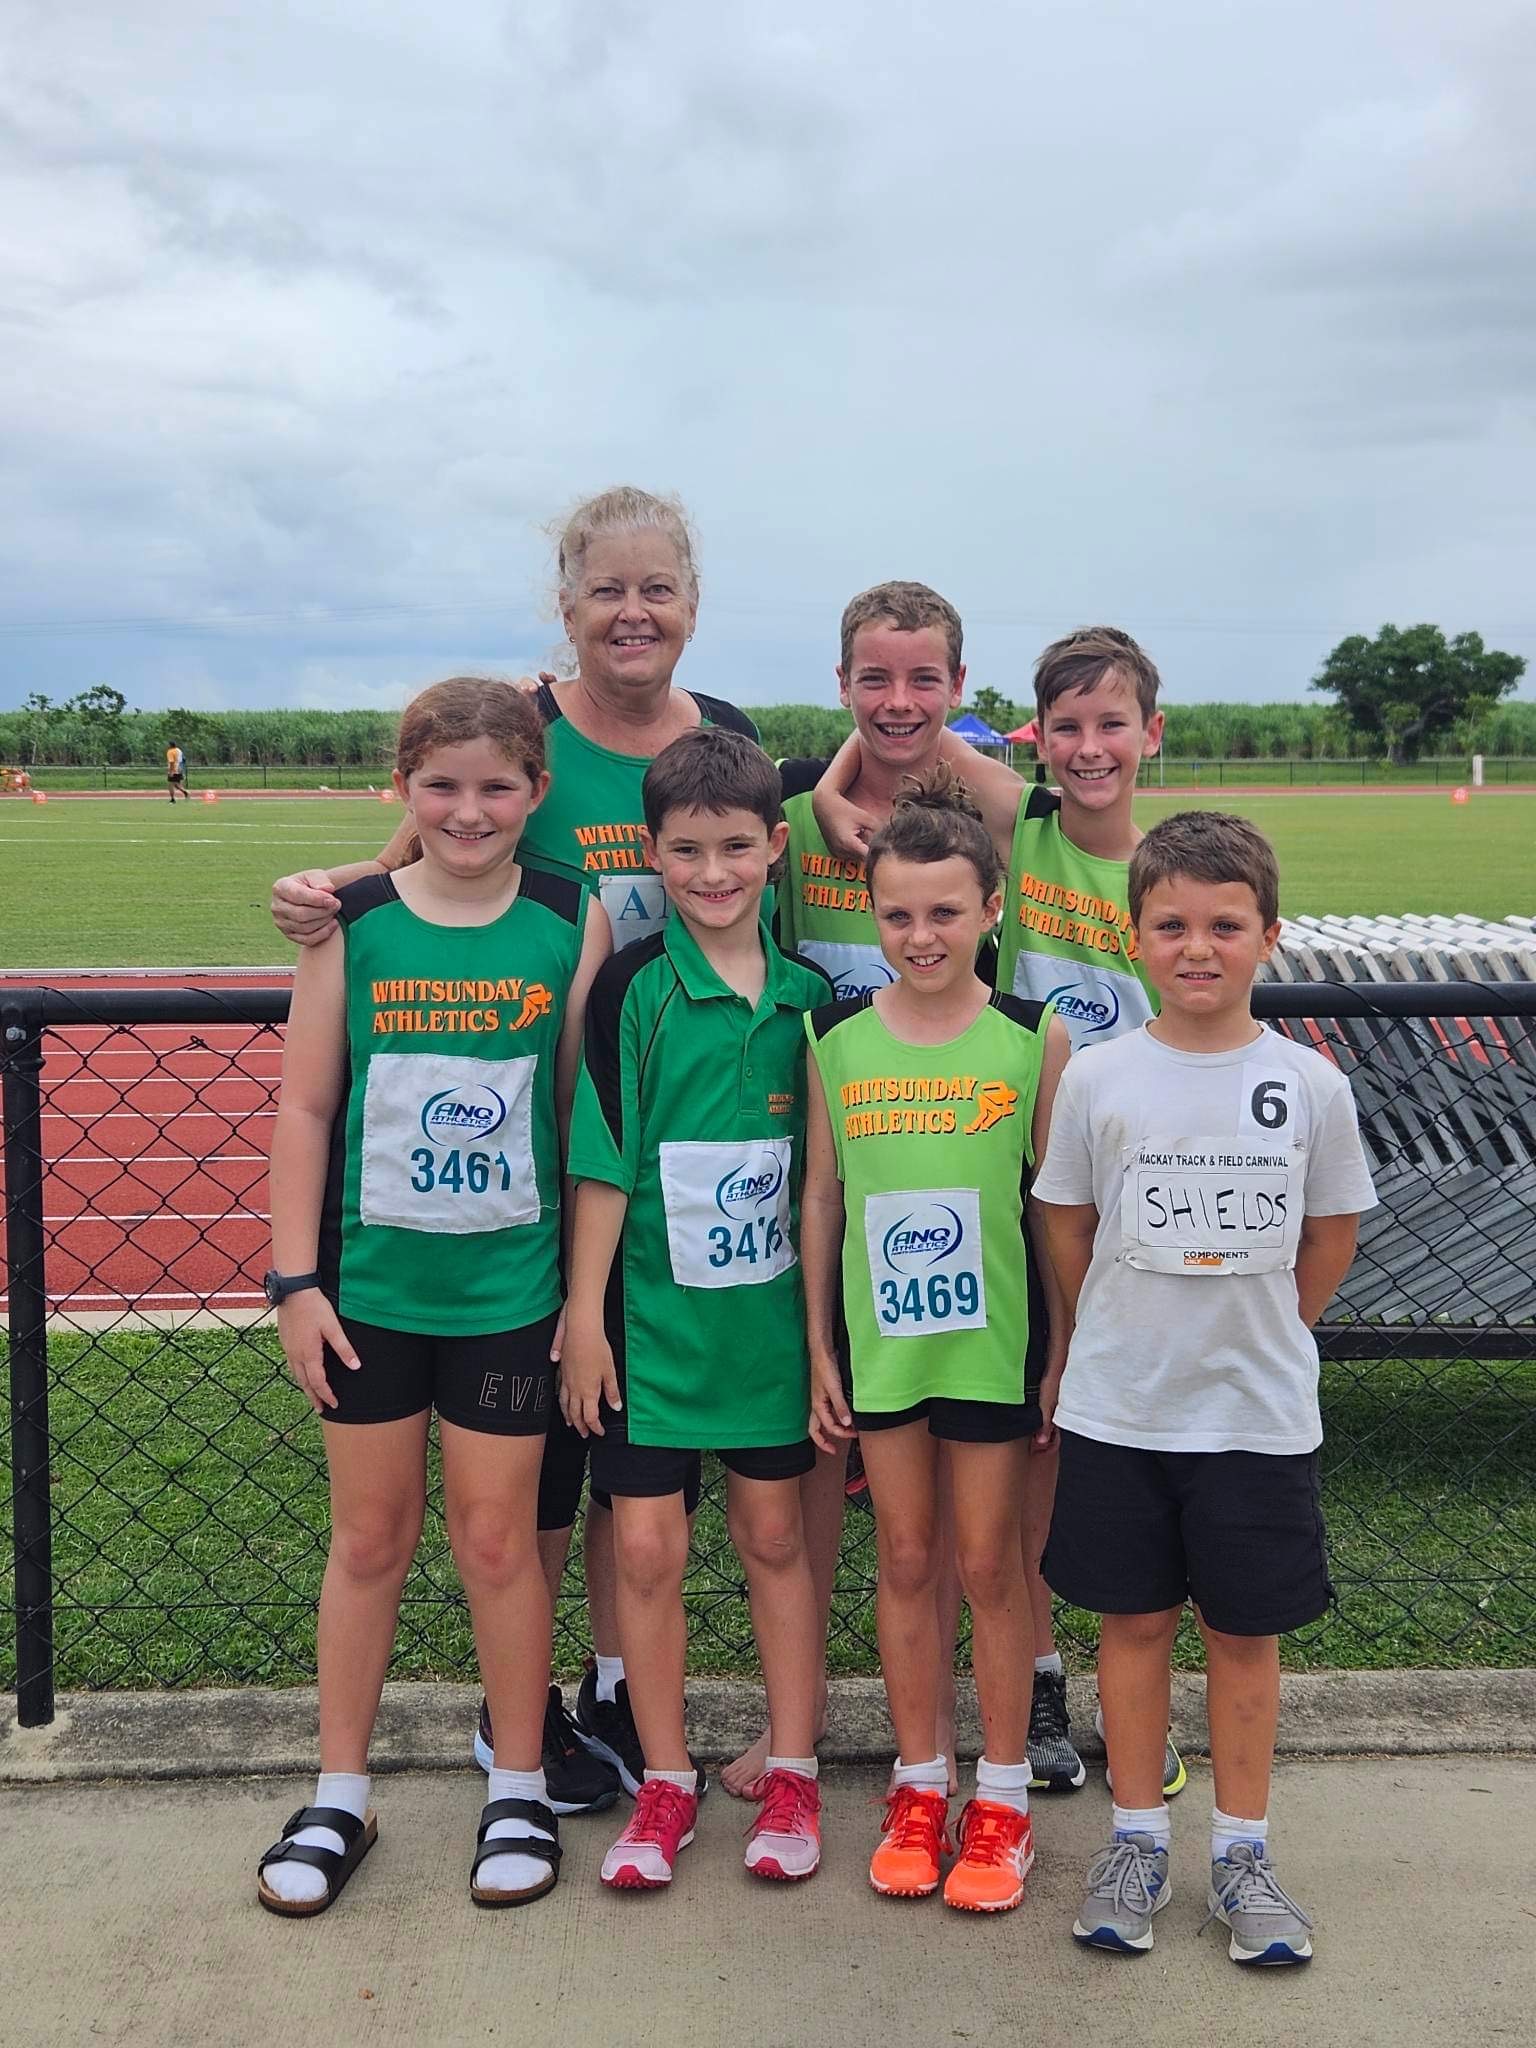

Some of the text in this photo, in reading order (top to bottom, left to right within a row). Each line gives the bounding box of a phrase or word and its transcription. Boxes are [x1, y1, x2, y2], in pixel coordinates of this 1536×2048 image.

[1019, 903, 1120, 954] ATHLETICS
[372, 979, 524, 1003] WHITSUNDAY
[1056, 995, 1109, 1016] ANQ
[373, 1009, 499, 1033] ATHLETICS
[841, 1077, 977, 1109] WHITSUNDAY
[1251, 1080, 1288, 1129] 6
[434, 1102, 494, 1120] ANQ
[846, 1109, 956, 1141] ATHLETICS
[410, 1148, 511, 1194] 3461
[1139, 1154, 1288, 1168] MACKAY TRACK & FIELD CARNIVAL
[728, 1173, 774, 1193] ANQ
[1145, 1186, 1287, 1232] SHIELDS
[893, 1227, 951, 1246] ANQ
[1183, 1251, 1249, 1259] COMPONENTS
[880, 1272, 979, 1324] 3469
